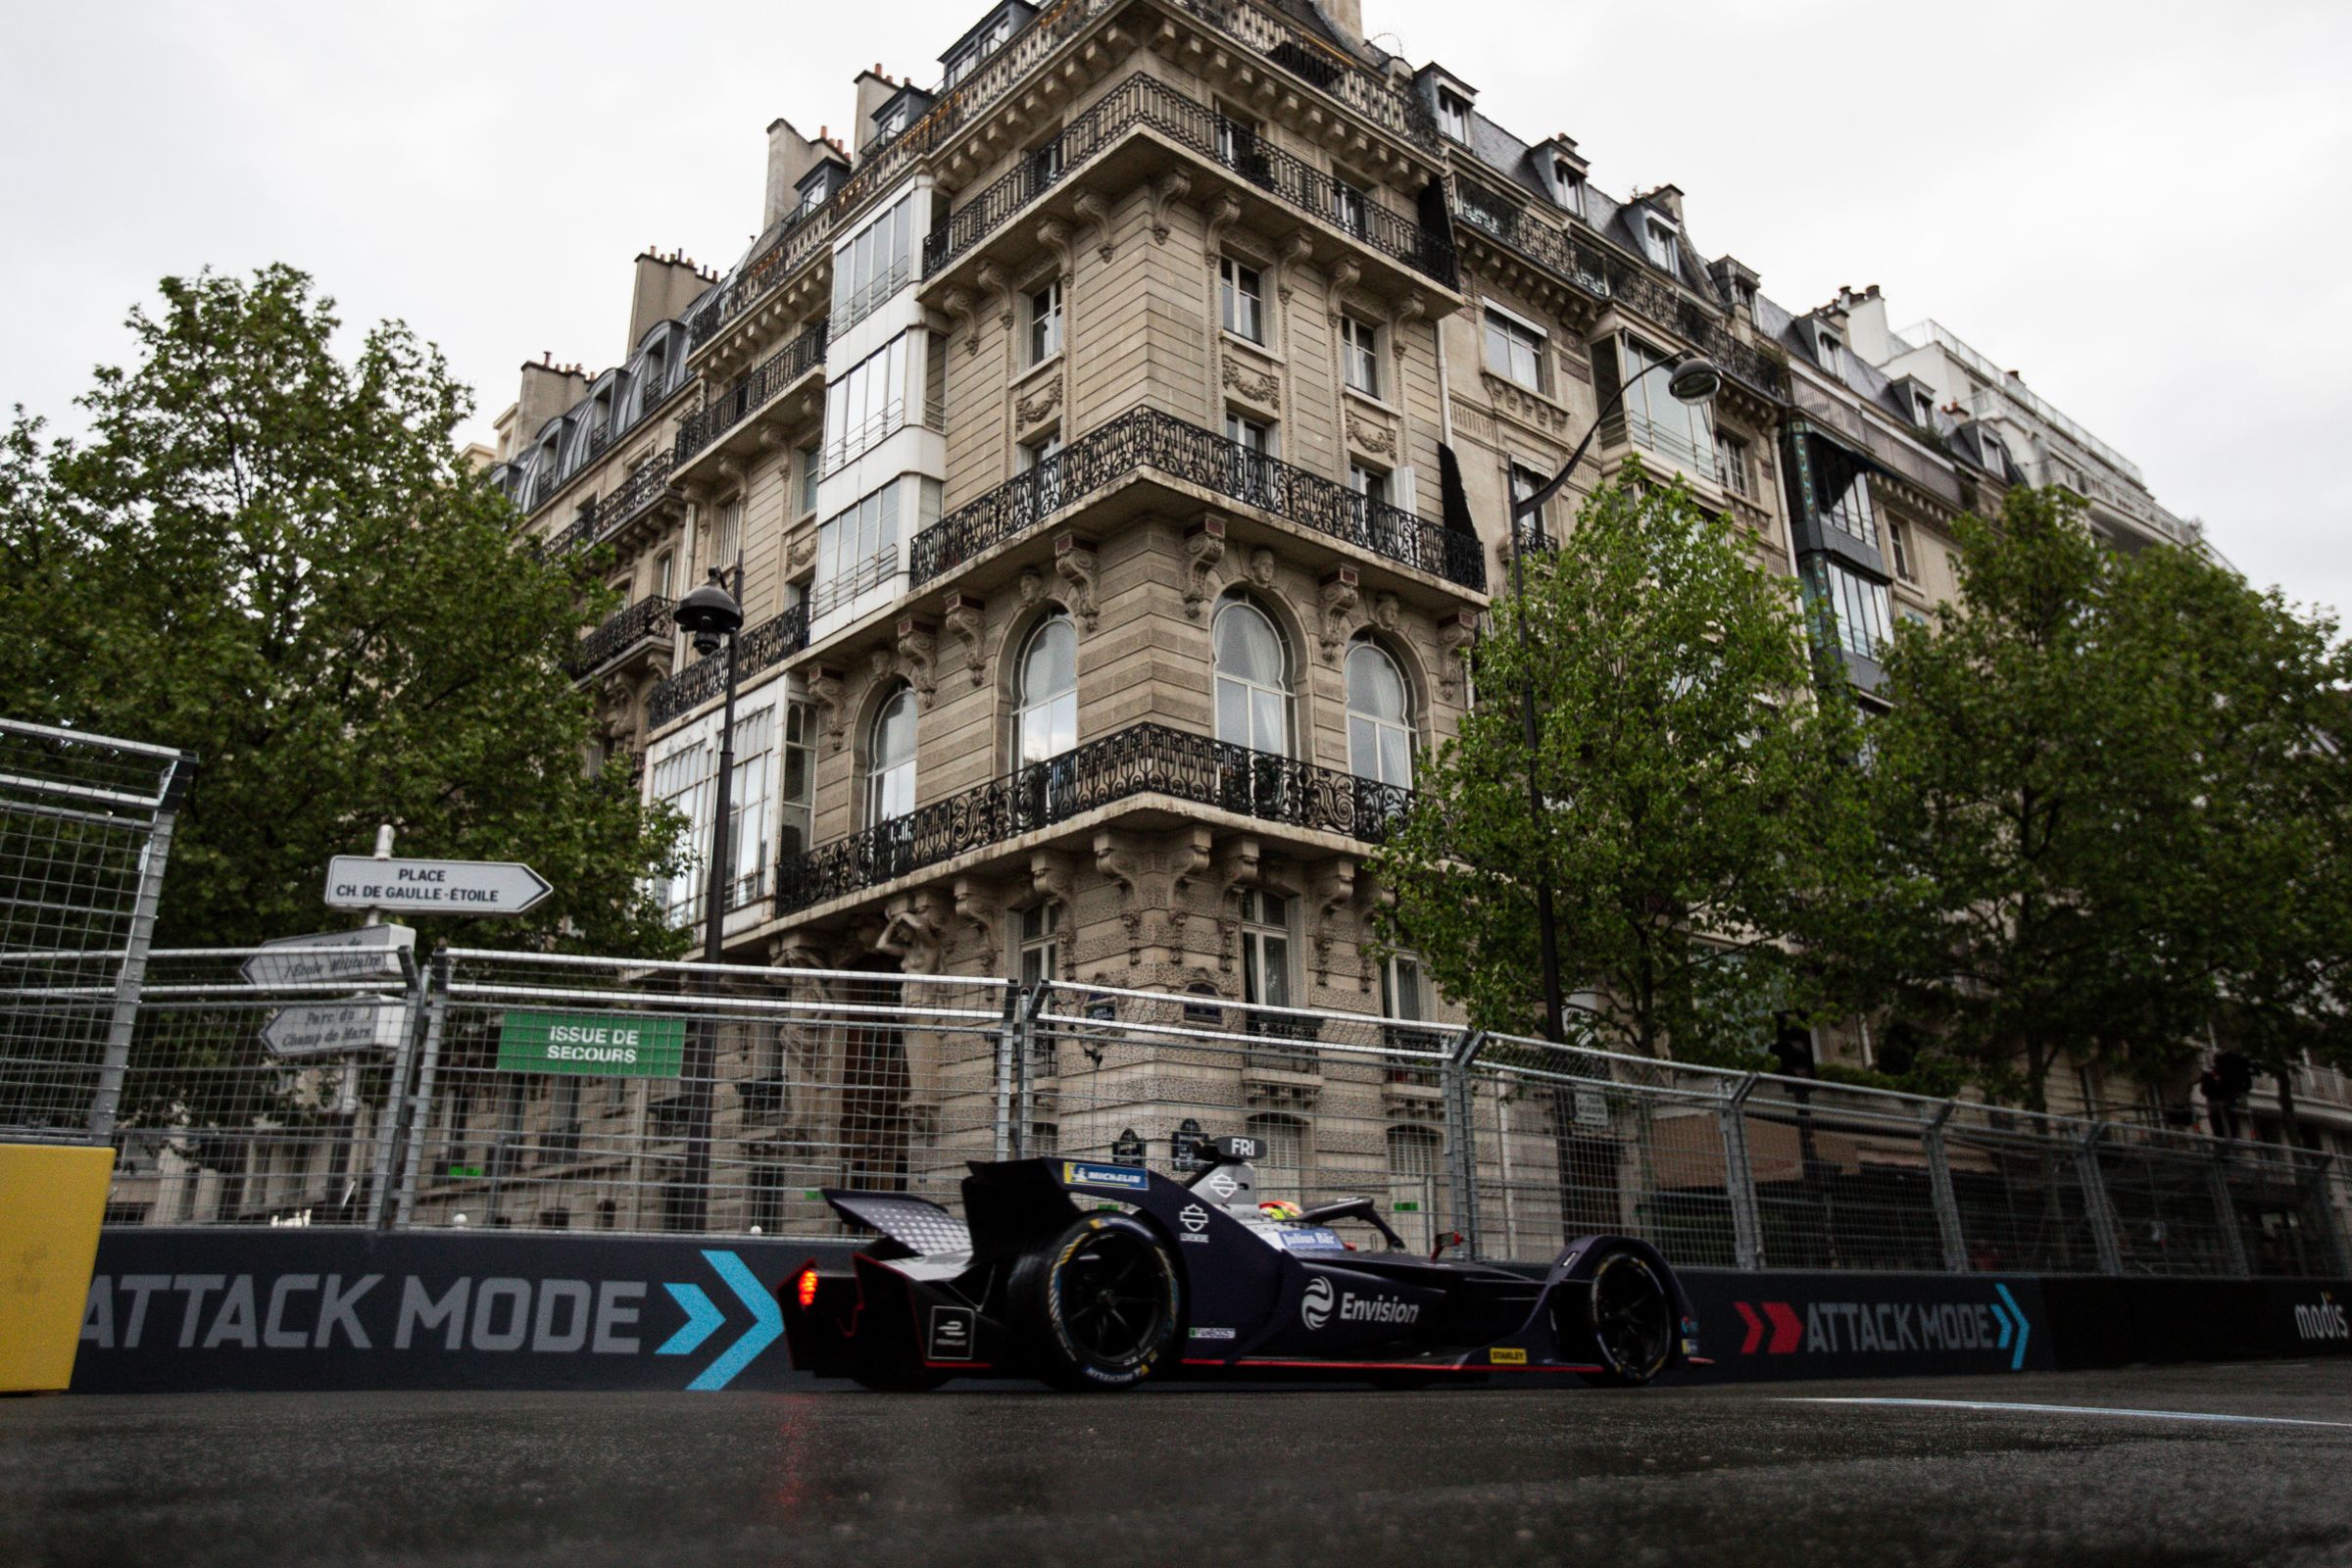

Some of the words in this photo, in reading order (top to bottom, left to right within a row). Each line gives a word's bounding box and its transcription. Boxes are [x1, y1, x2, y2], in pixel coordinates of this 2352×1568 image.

[398, 868, 446, 882] PLACE
[363, 885, 381, 898] DE
[339, 1007, 355, 1022] du
[282, 1032, 322, 1047] Champ
[324, 1029, 339, 1042] de
[345, 1026, 372, 1039] Mars
[549, 1025, 608, 1044] ISSUE
[612, 1029, 639, 1045] DE
[547, 1045, 637, 1063] SECOURS
[1231, 1137, 1255, 1156] FRI
[1088, 1170, 1142, 1183] MICHELIN
[80, 1273, 384, 1348] ATTACK
[395, 1275, 648, 1354] MODE
[1340, 1292, 1420, 1324] Envision
[2294, 1291, 2348, 1340] modis
[1807, 1301, 1921, 1353] ATTACK
[1918, 1301, 1995, 1350] MODE
